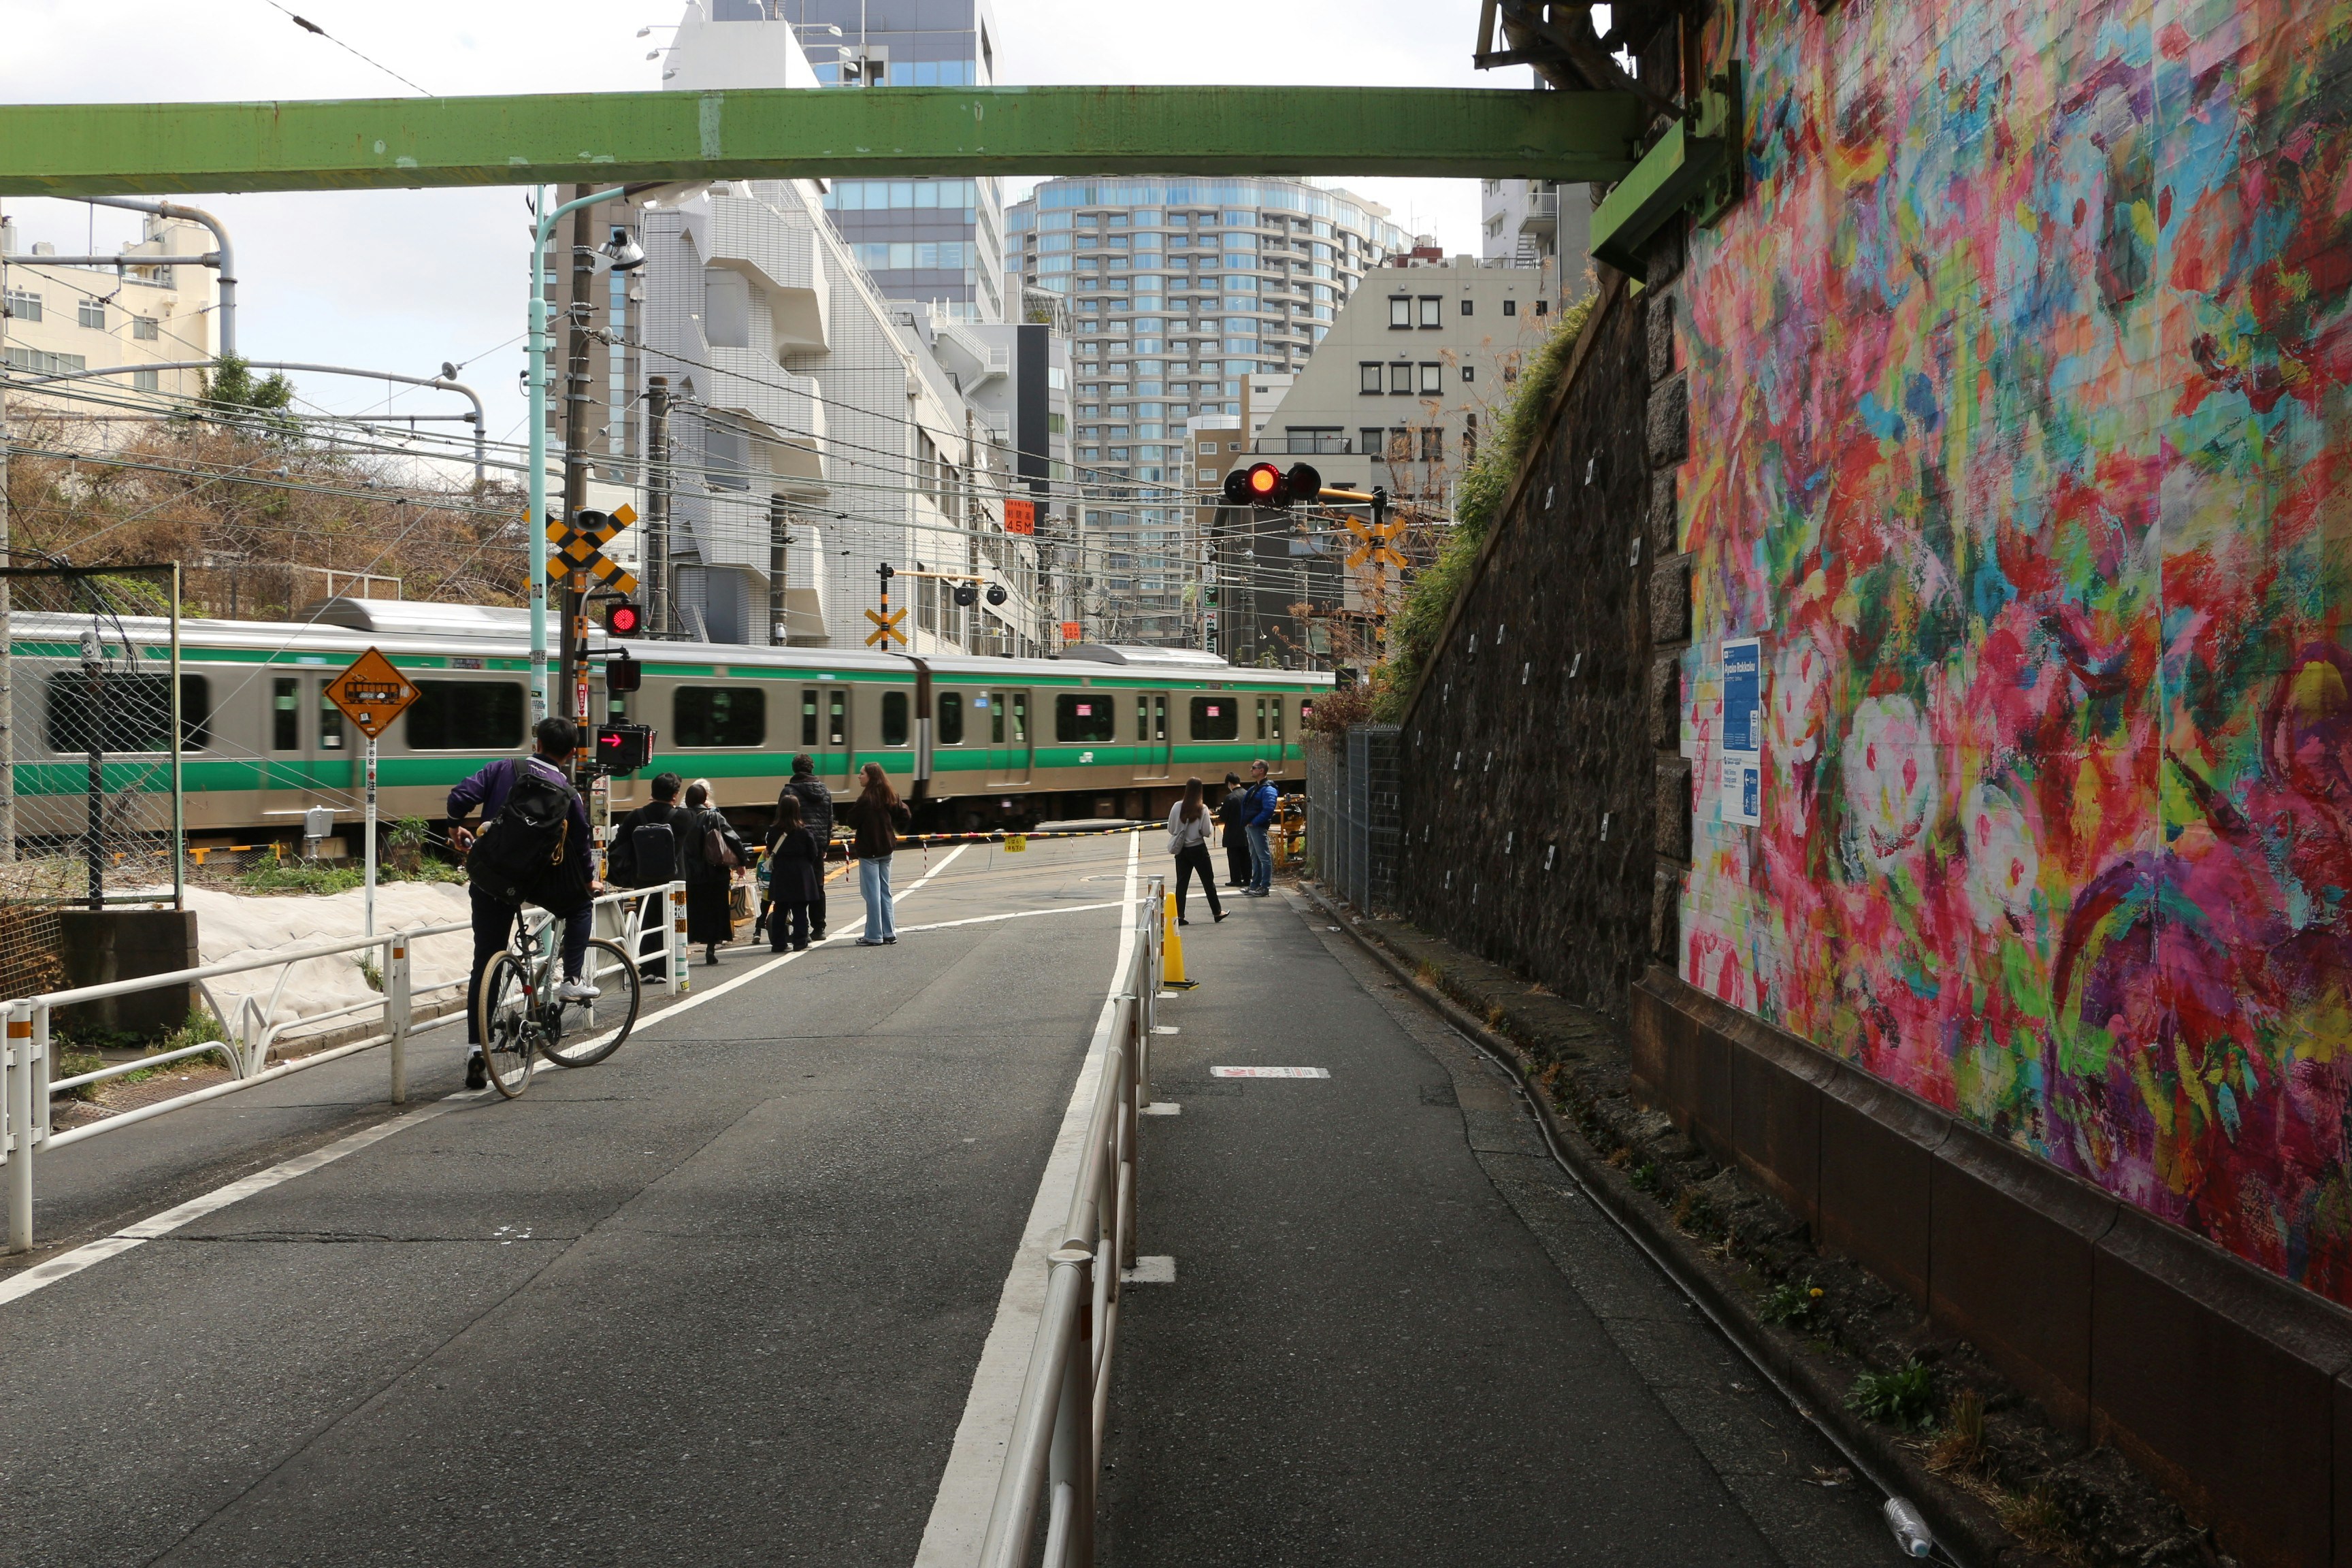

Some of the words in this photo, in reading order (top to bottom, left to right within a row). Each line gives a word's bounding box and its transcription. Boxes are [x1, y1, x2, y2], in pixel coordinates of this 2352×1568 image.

[1007, 520, 1031, 532] 4.5M
[541, 651, 546, 660] 8
[1079, 751, 1094, 763] JR
[368, 781, 376, 803] 注意
